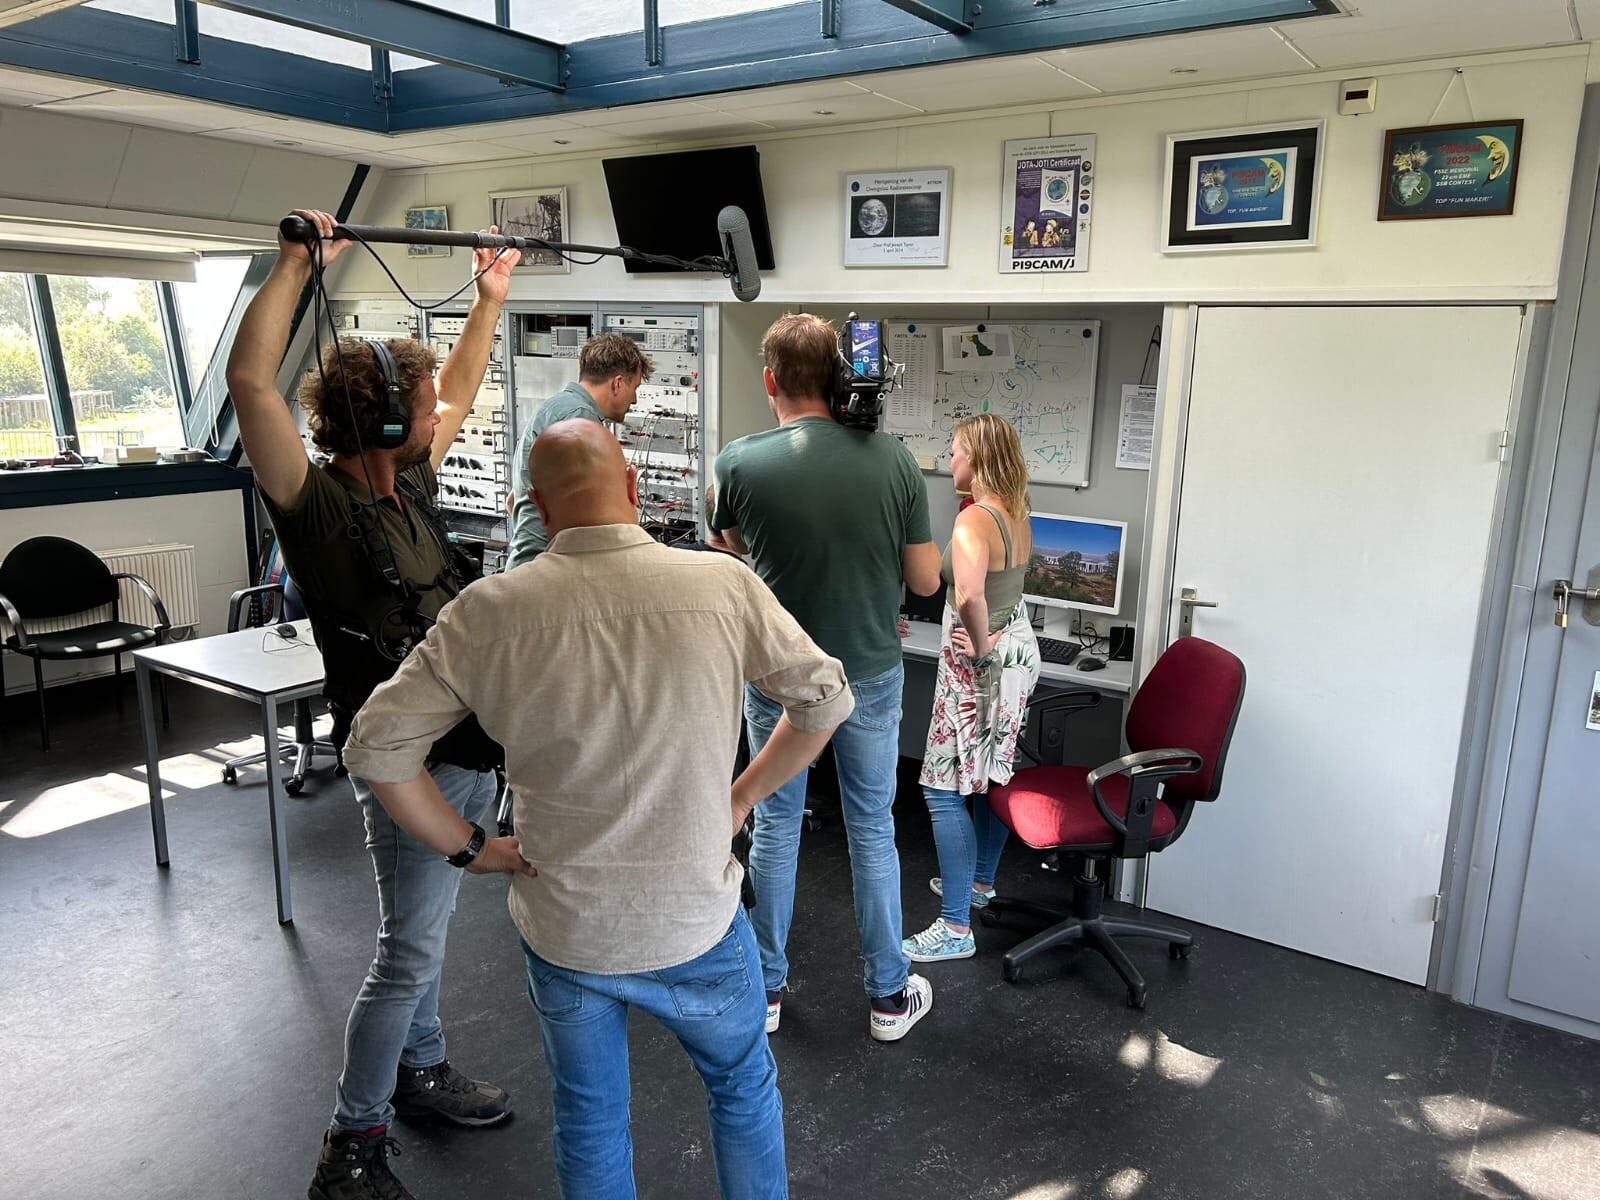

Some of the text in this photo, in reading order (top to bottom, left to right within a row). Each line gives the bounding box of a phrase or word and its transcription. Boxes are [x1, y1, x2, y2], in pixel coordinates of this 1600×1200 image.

[1018, 158, 1080, 169] JOTA-JOTI Certificaat
[1446, 156, 1470, 165] 2022
[1012, 259, 1075, 271] PI9CAM/J
